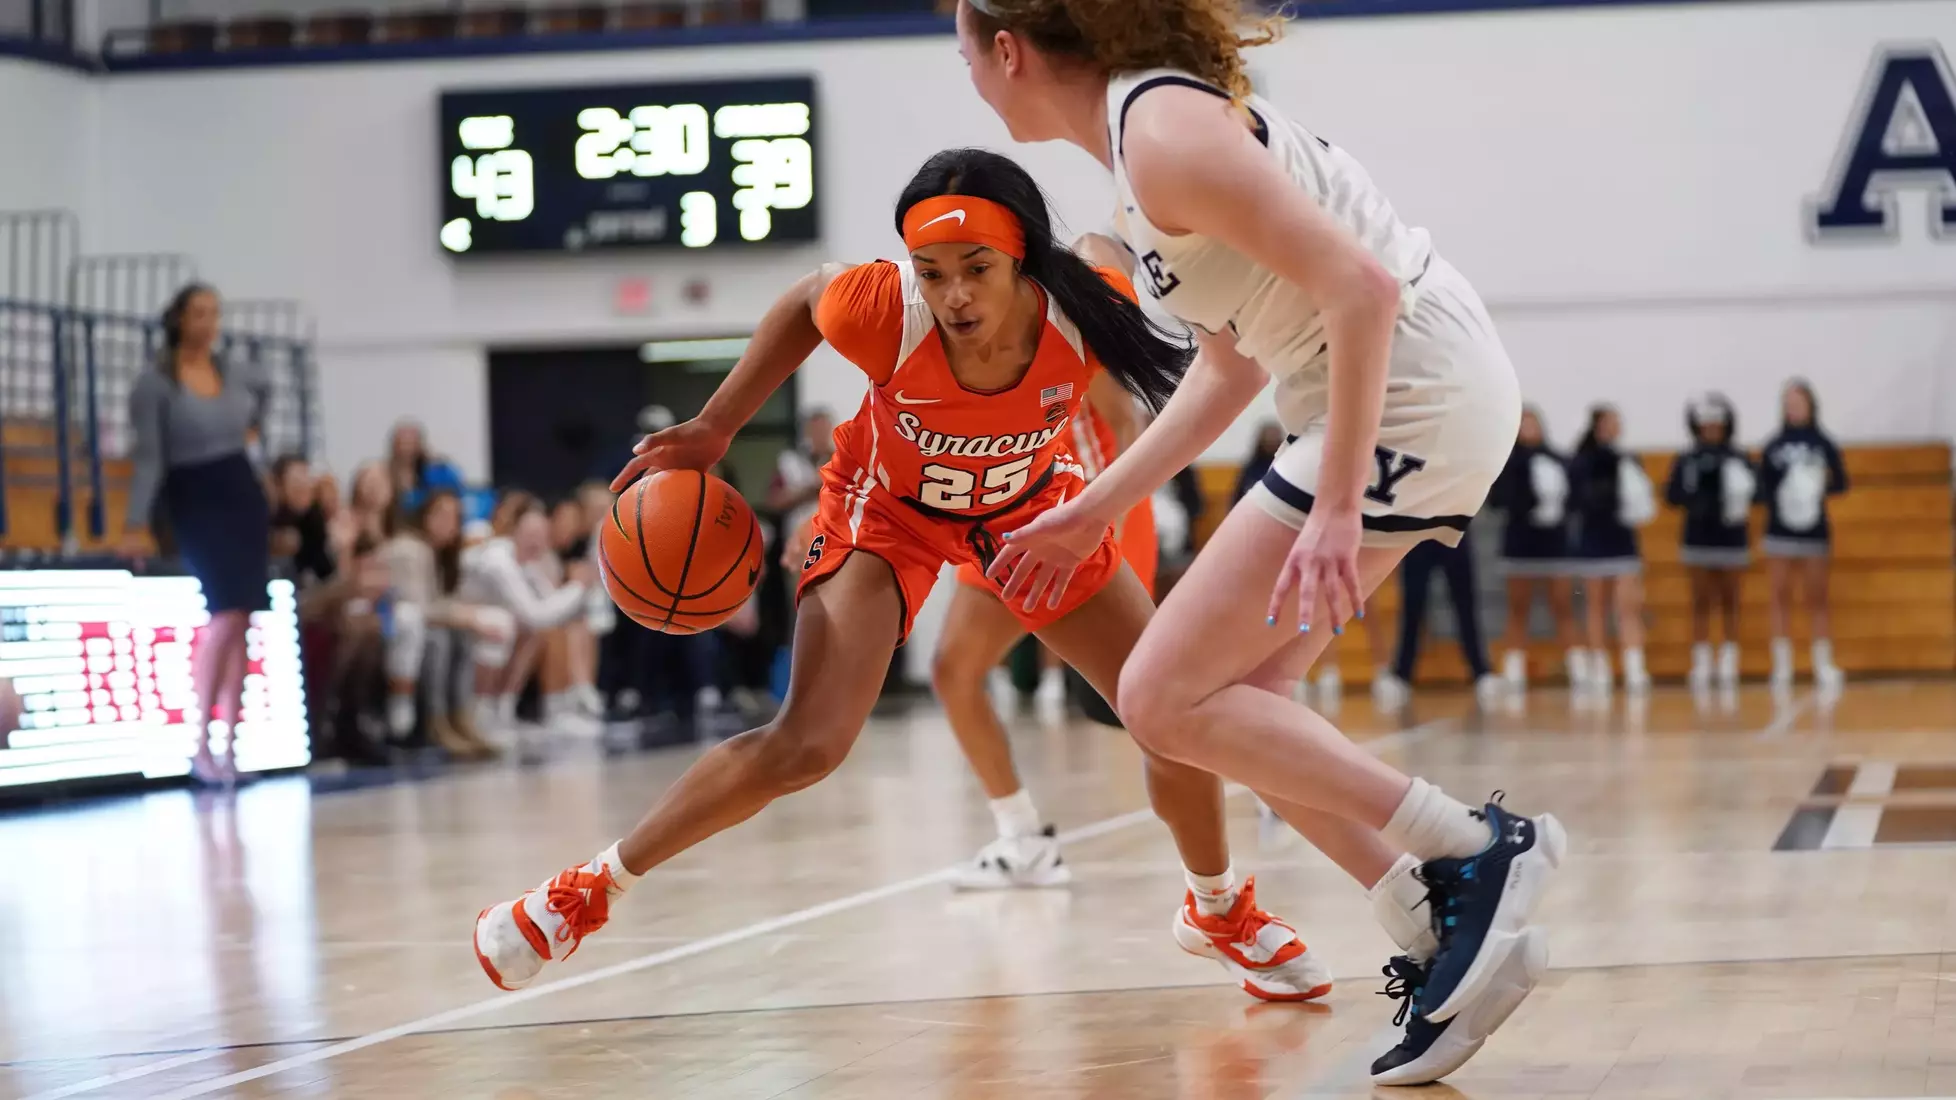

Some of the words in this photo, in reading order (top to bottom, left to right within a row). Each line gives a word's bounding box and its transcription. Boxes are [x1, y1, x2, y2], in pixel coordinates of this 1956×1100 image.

[575, 104, 709, 179] 2:30
[731, 138, 812, 209] 39
[918, 454, 1035, 510] 25
[1363, 444, 1427, 507] Y
[803, 533, 826, 571] S
